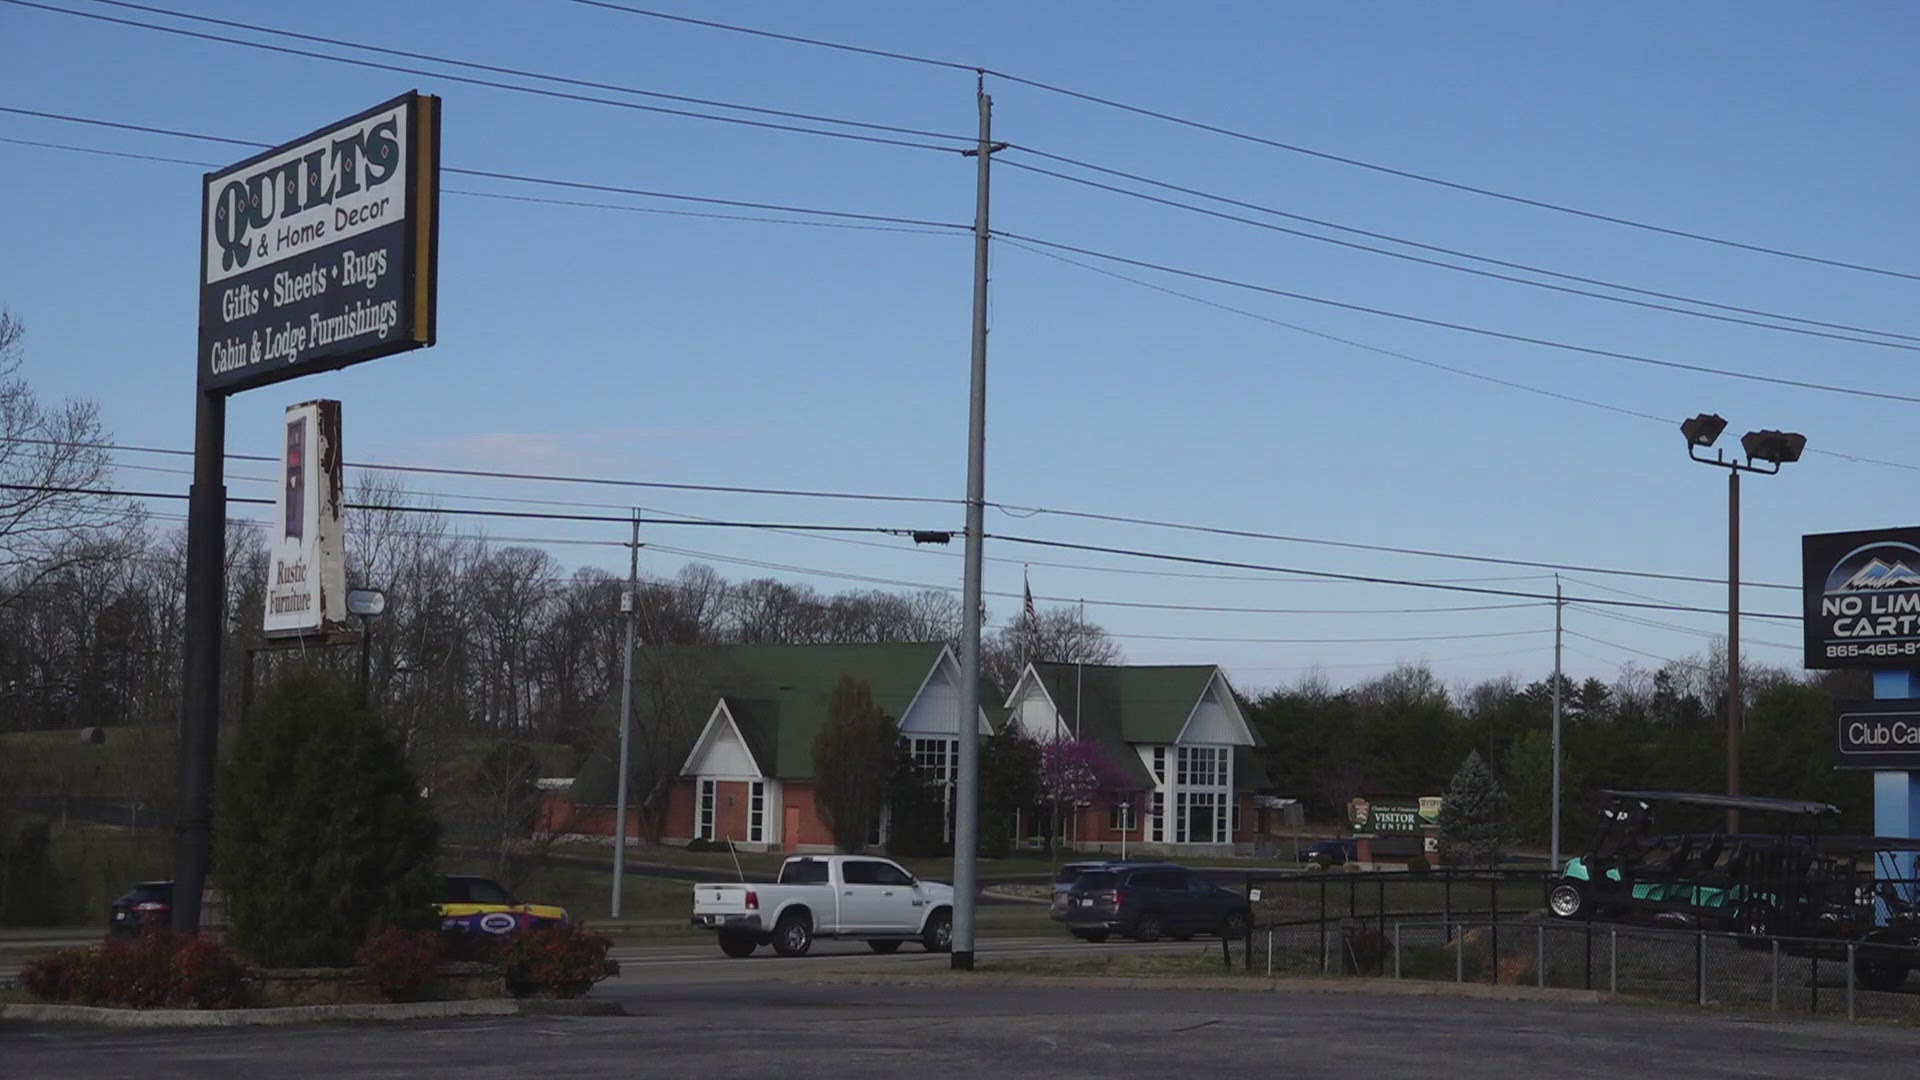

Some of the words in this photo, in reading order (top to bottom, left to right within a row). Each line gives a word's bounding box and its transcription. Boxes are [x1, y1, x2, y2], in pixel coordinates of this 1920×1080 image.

[215, 114, 400, 272] QUILTS
[257, 233, 269, 257] &
[276, 217, 325, 252] Home
[335, 197, 390, 232] Decor
[222, 284, 259, 323] Gifts
[273, 263, 327, 308] Sheets
[342, 249, 388, 289] Rugs
[211, 333, 247, 376] Cabin
[250, 330, 262, 365] &
[264, 323, 306, 364] Lodge
[308, 299, 398, 340] Furnishings
[276, 557, 307, 586] Rustic
[268, 587, 312, 615] Furniture
[1822, 596, 1863, 617] NO
[1833, 615, 1920, 637] CART
[1848, 722, 1890, 745] Club
[1375, 813, 1415, 823] VISITOR
